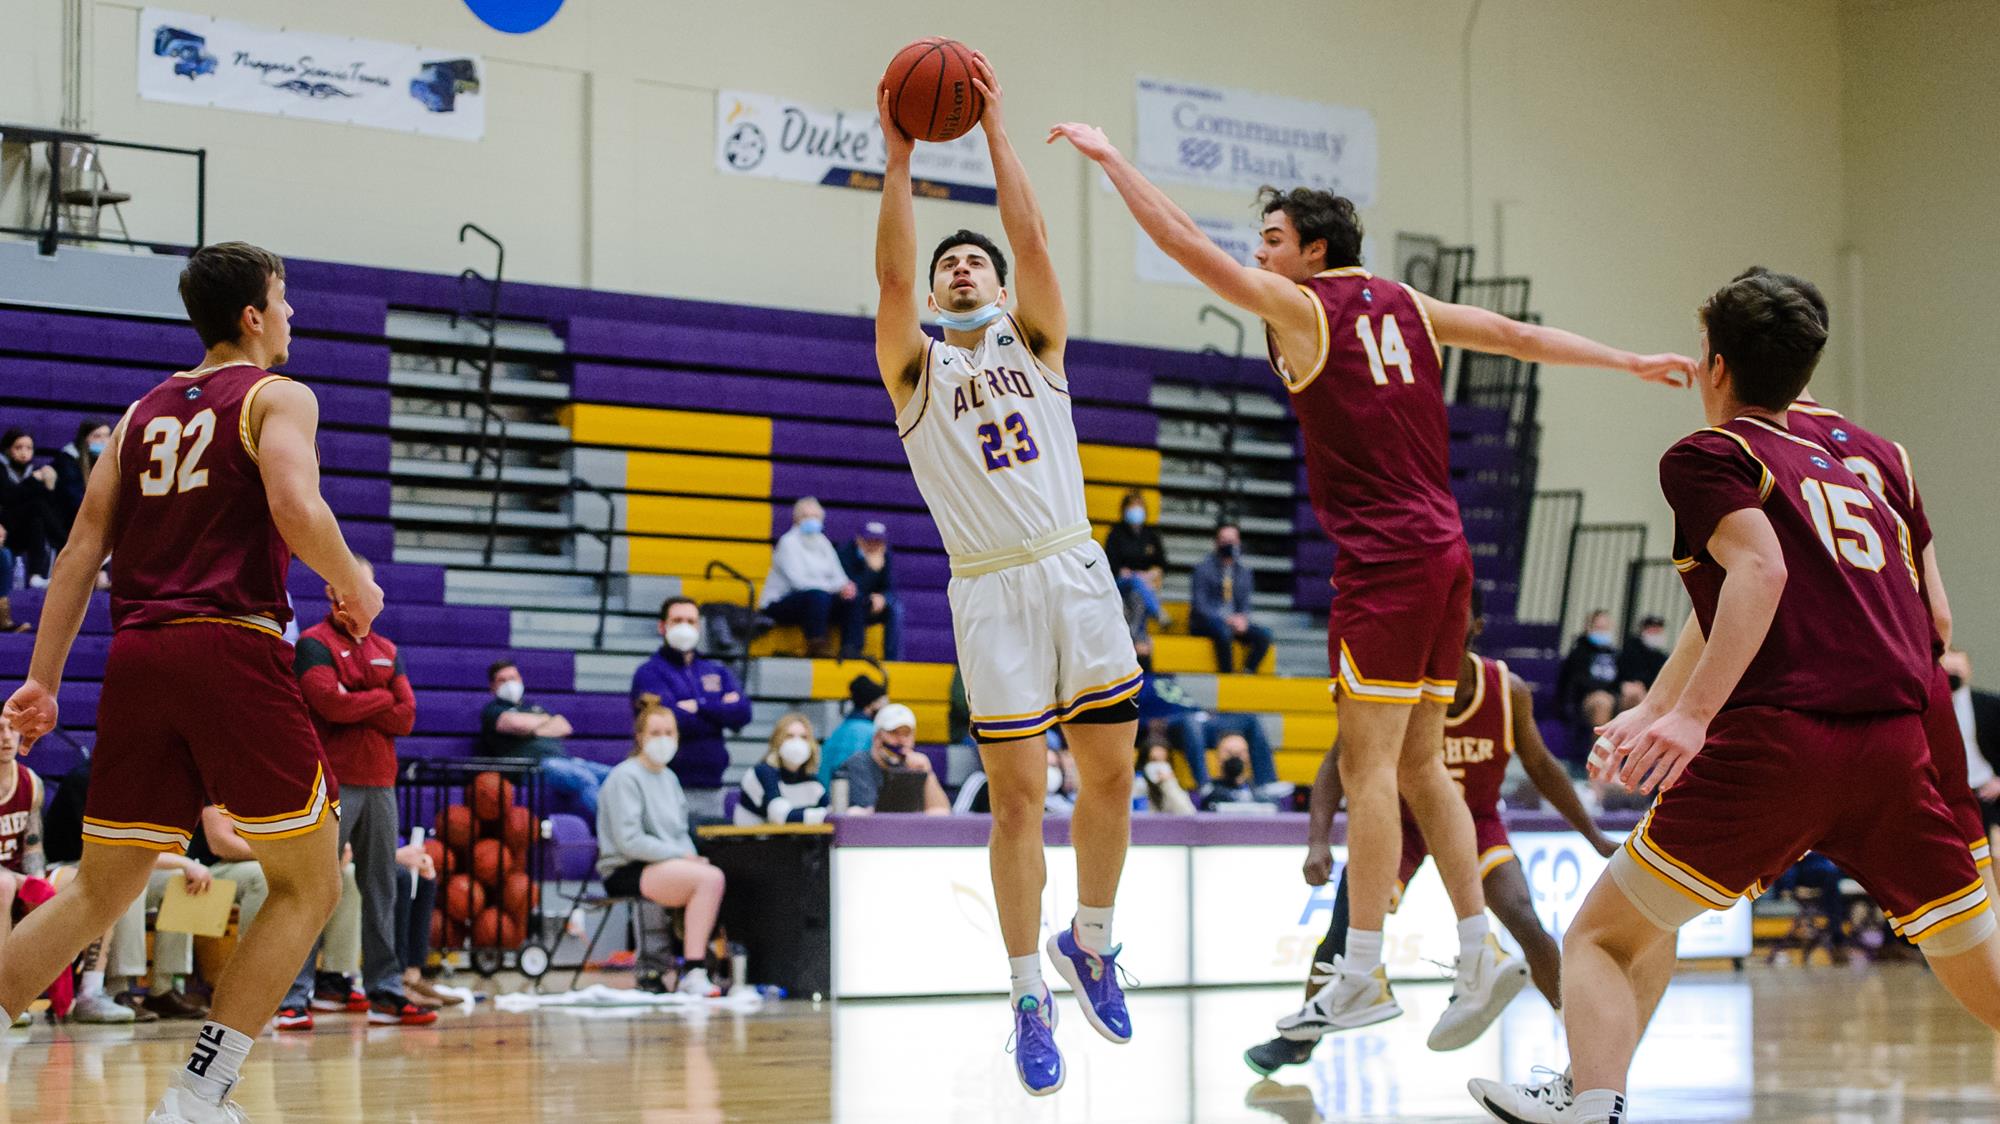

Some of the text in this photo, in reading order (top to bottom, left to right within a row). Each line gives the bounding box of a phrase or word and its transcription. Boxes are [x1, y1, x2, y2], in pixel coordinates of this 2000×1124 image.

[1172, 101, 1347, 162] Community
[1230, 144, 1304, 179] Bank
[1355, 313, 1415, 386] 14
[954, 366, 1035, 421] ALRED
[140, 408, 217, 496] 32
[976, 410, 1040, 473] 23
[1800, 476, 1886, 573] 15
